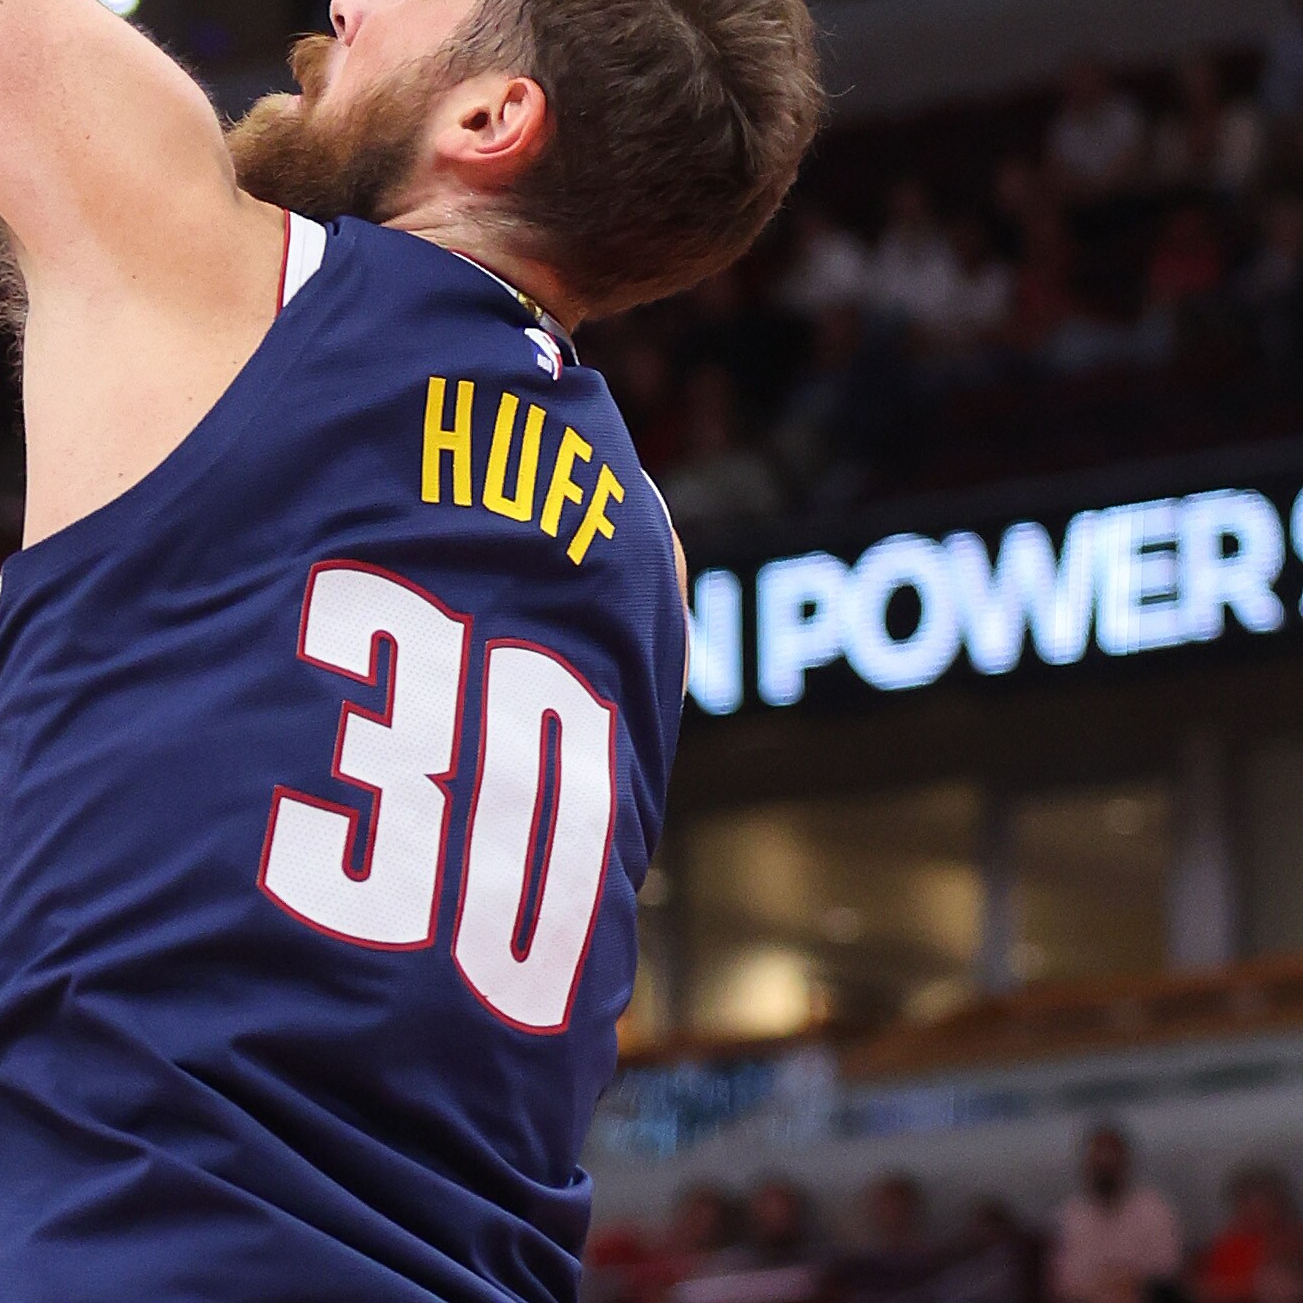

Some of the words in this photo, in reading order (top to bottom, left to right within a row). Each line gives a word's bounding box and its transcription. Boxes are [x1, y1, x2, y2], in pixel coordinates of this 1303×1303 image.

[421, 376, 625, 566] HUFF
[755, 488, 1285, 706] POWER
[256, 559, 618, 1036] 30
